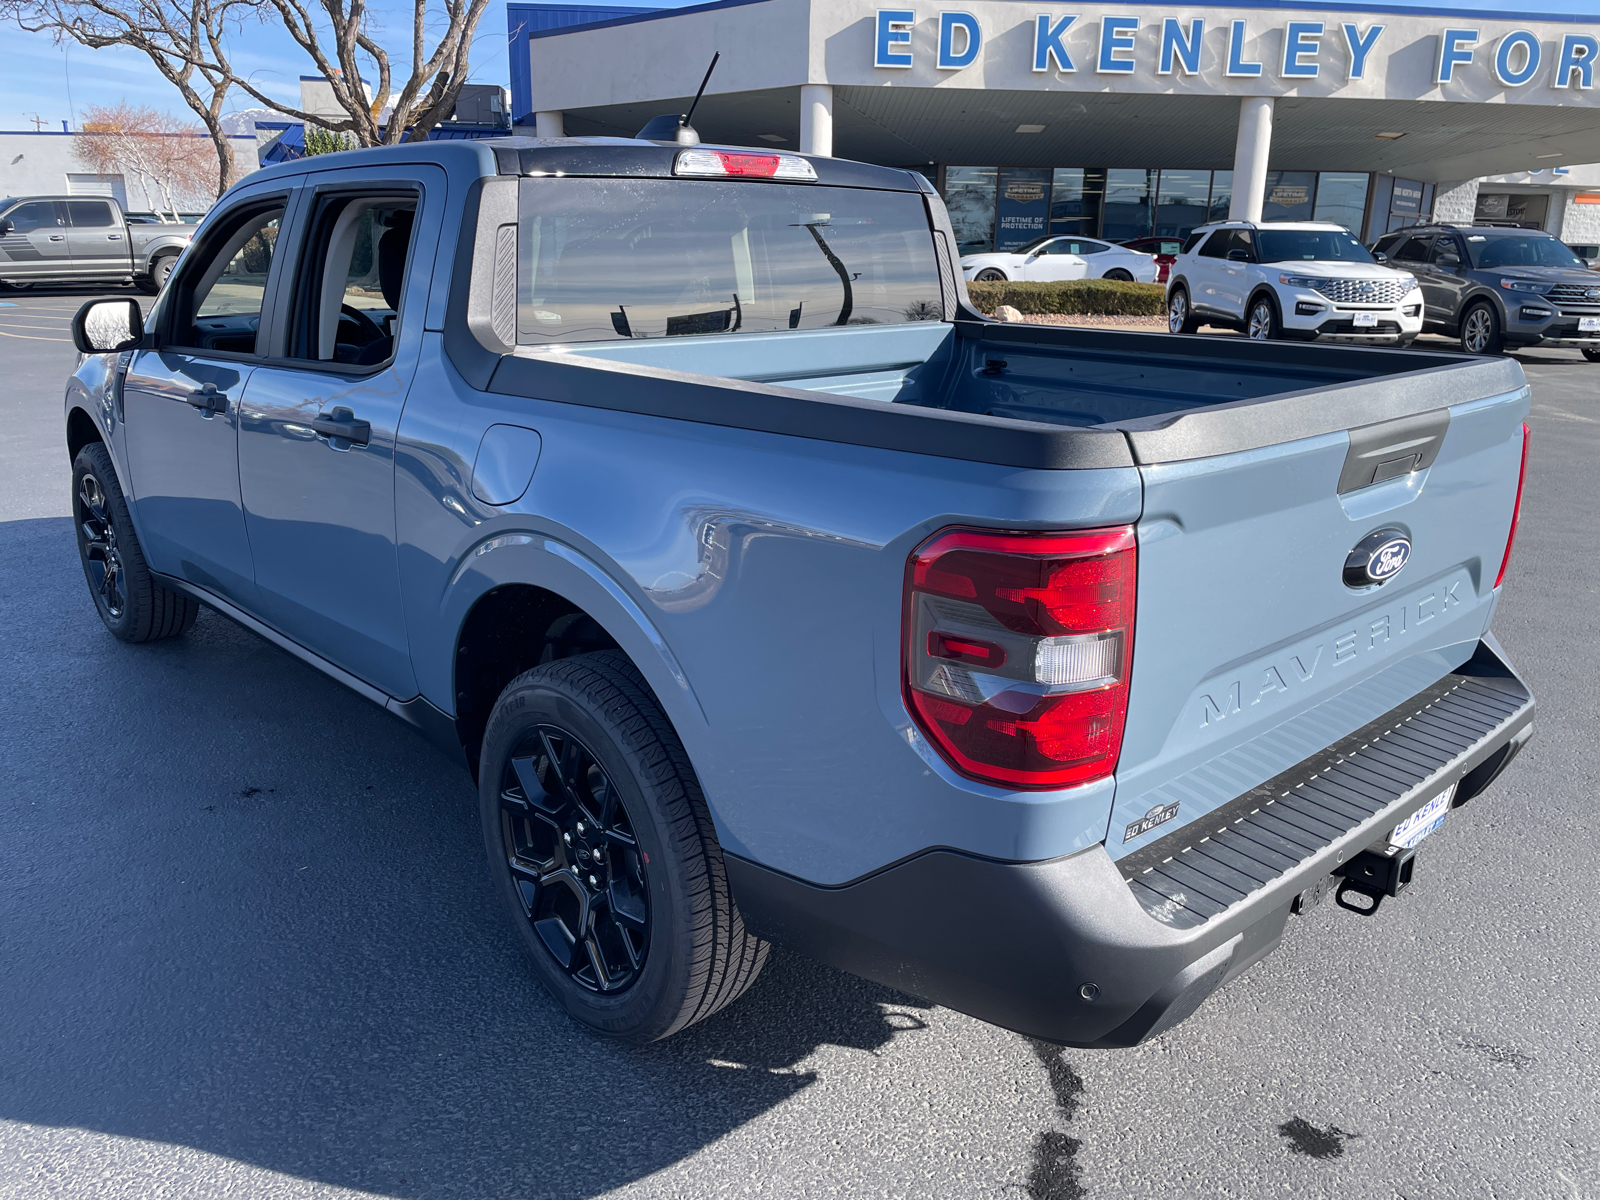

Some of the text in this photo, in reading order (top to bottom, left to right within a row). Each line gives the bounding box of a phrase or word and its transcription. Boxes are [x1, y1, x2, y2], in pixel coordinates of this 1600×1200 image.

[874, 9, 1600, 89] ED KENLEY FOR
[1376, 545, 1405, 575] Ford
[1199, 580, 1460, 729] MAVERICK
[1125, 824, 1140, 840] ED
[1141, 805, 1179, 832] KENLEY
